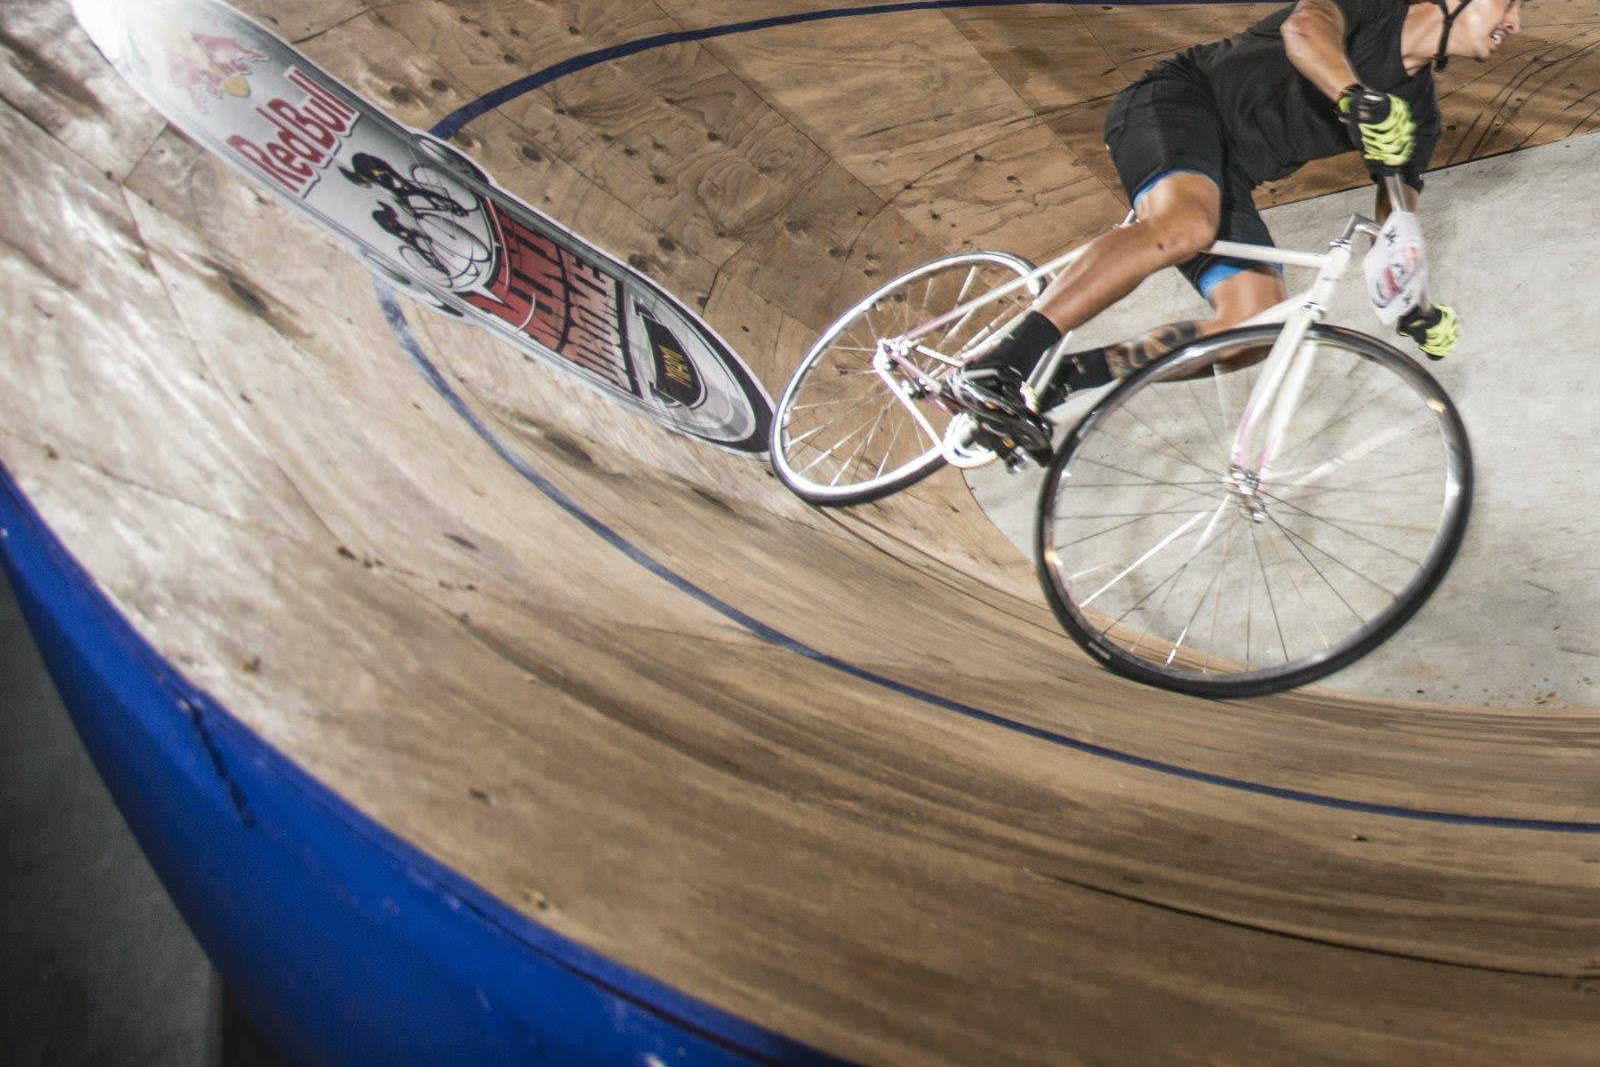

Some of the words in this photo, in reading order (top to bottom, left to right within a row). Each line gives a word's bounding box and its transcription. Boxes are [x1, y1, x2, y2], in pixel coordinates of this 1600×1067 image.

[226, 106, 326, 193] Red
[267, 69, 357, 151] Bull
[462, 197, 563, 352] MINI
[556, 246, 634, 395] DROME
